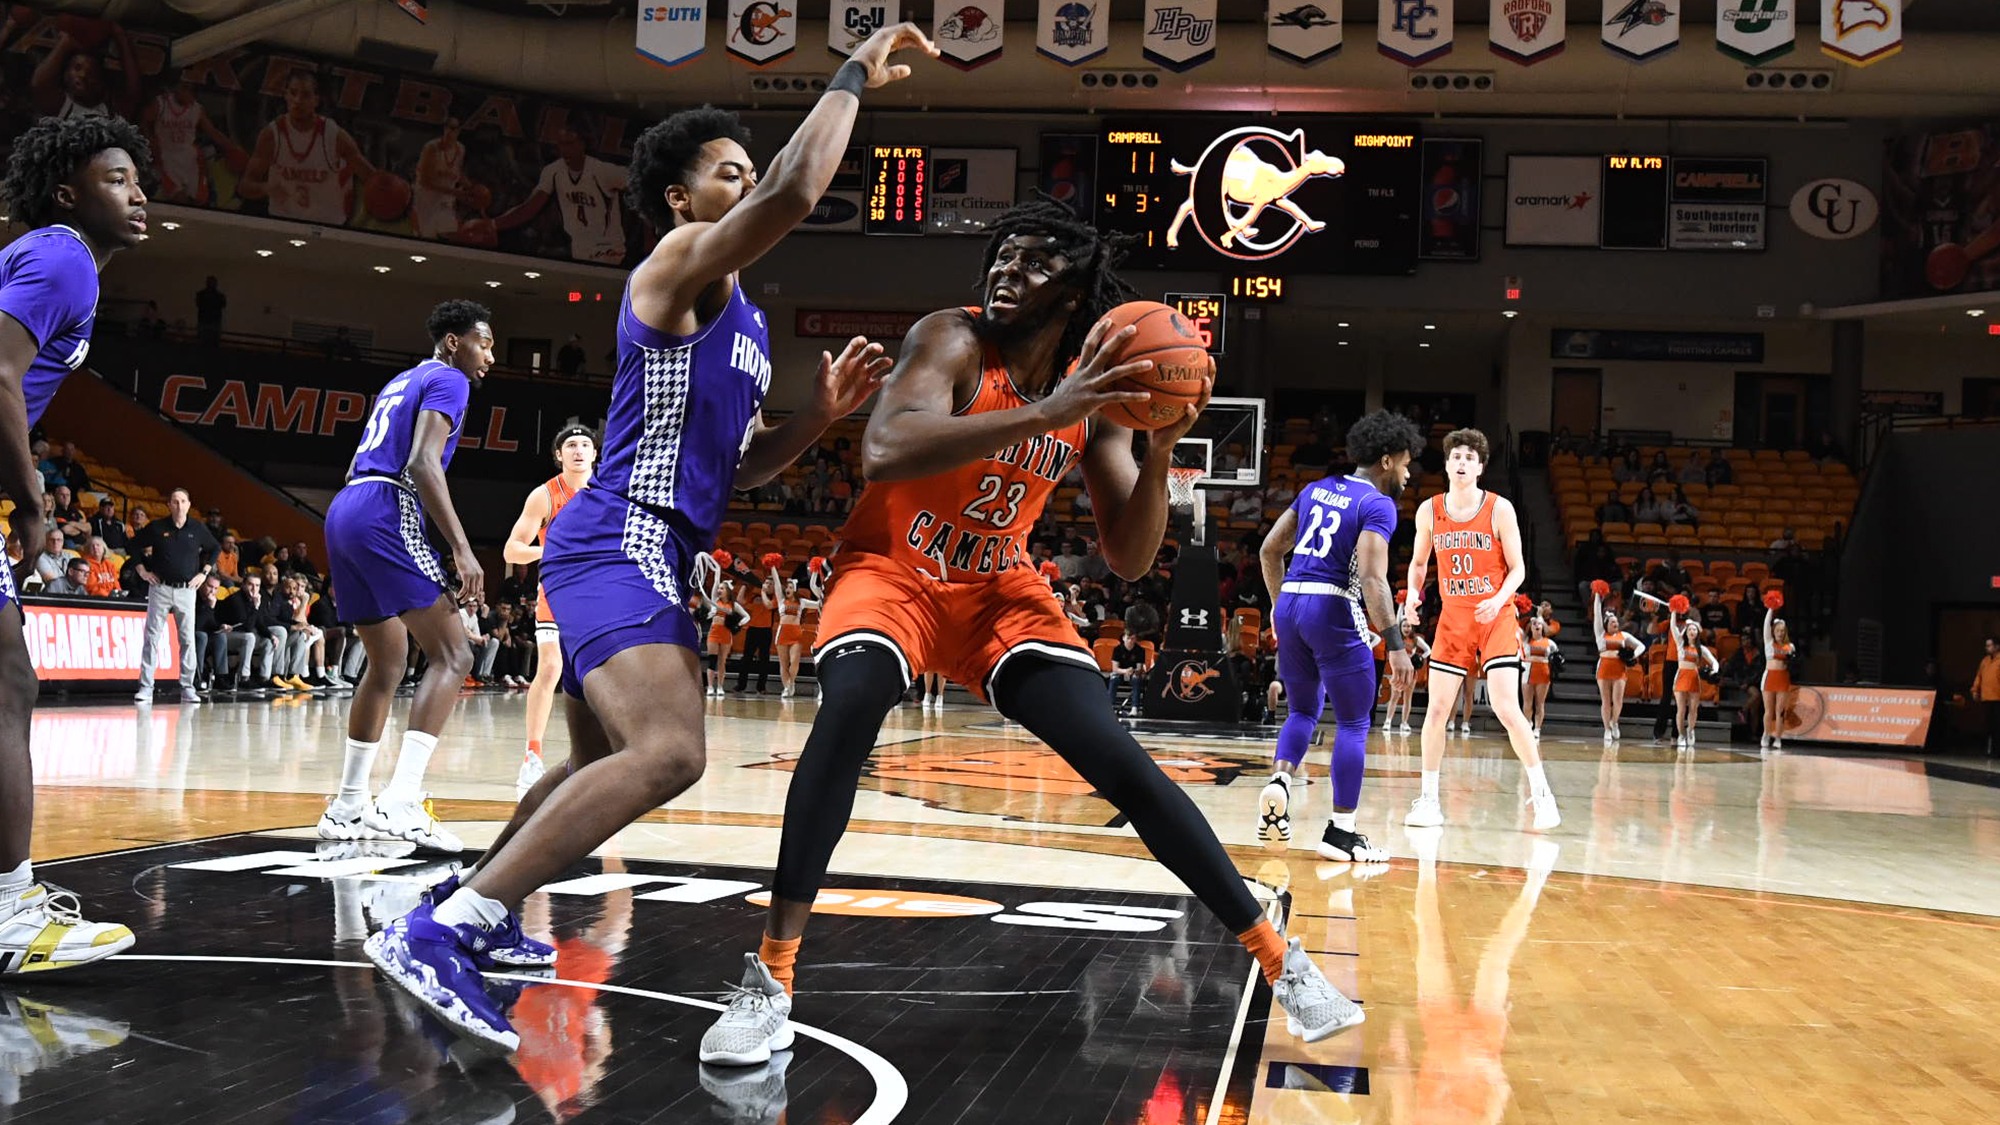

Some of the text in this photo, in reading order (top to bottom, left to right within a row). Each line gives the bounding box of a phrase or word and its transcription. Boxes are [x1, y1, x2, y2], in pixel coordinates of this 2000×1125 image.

[1504, 0, 1552, 15] RADFORD
[845, 7, 884, 36] CSU
[1723, 9, 1788, 23] Spartans
[1148, 7, 1213, 46] HPU
[1108, 132, 1162, 144] CAMPBELL
[1354, 135, 1414, 148] HIGHPOINT
[875, 148, 922, 158] PLY FL PTS
[883, 159, 924, 171] 1 0 2
[1131, 151, 1154, 174] 11
[1610, 157, 1663, 169] PLY FL PTS
[879, 171, 924, 183] 2 0 0
[1676, 172, 1762, 189] CAMPBELL
[874, 184, 923, 196] 13 0 2
[870, 196, 922, 208] 23 0 2
[932, 197, 1010, 209] First Citizens
[1105, 193, 1116, 207] 4
[1136, 193, 1147, 213] 3
[1515, 195, 1570, 206] aramark
[870, 208, 922, 221] 30 0 3
[1676, 210, 1760, 222] Southeastern
[1808, 183, 1859, 234] CU
[1709, 222, 1757, 233] Interiors
[1147, 230, 1153, 248] 1
[1354, 240, 1379, 248] PERIOD
[1233, 276, 1281, 298] 11:54
[1177, 299, 1219, 317] 11:54
[159, 374, 519, 452] CAMPL
[356, 395, 404, 454] 55
[960, 473, 1027, 529] 23
[1311, 487, 1353, 510] WILLIAMS
[1294, 504, 1342, 559] 23
[906, 510, 1021, 575] CAMELS
[1433, 530, 1492, 553] FIGHTING
[1451, 553, 1473, 575] 30
